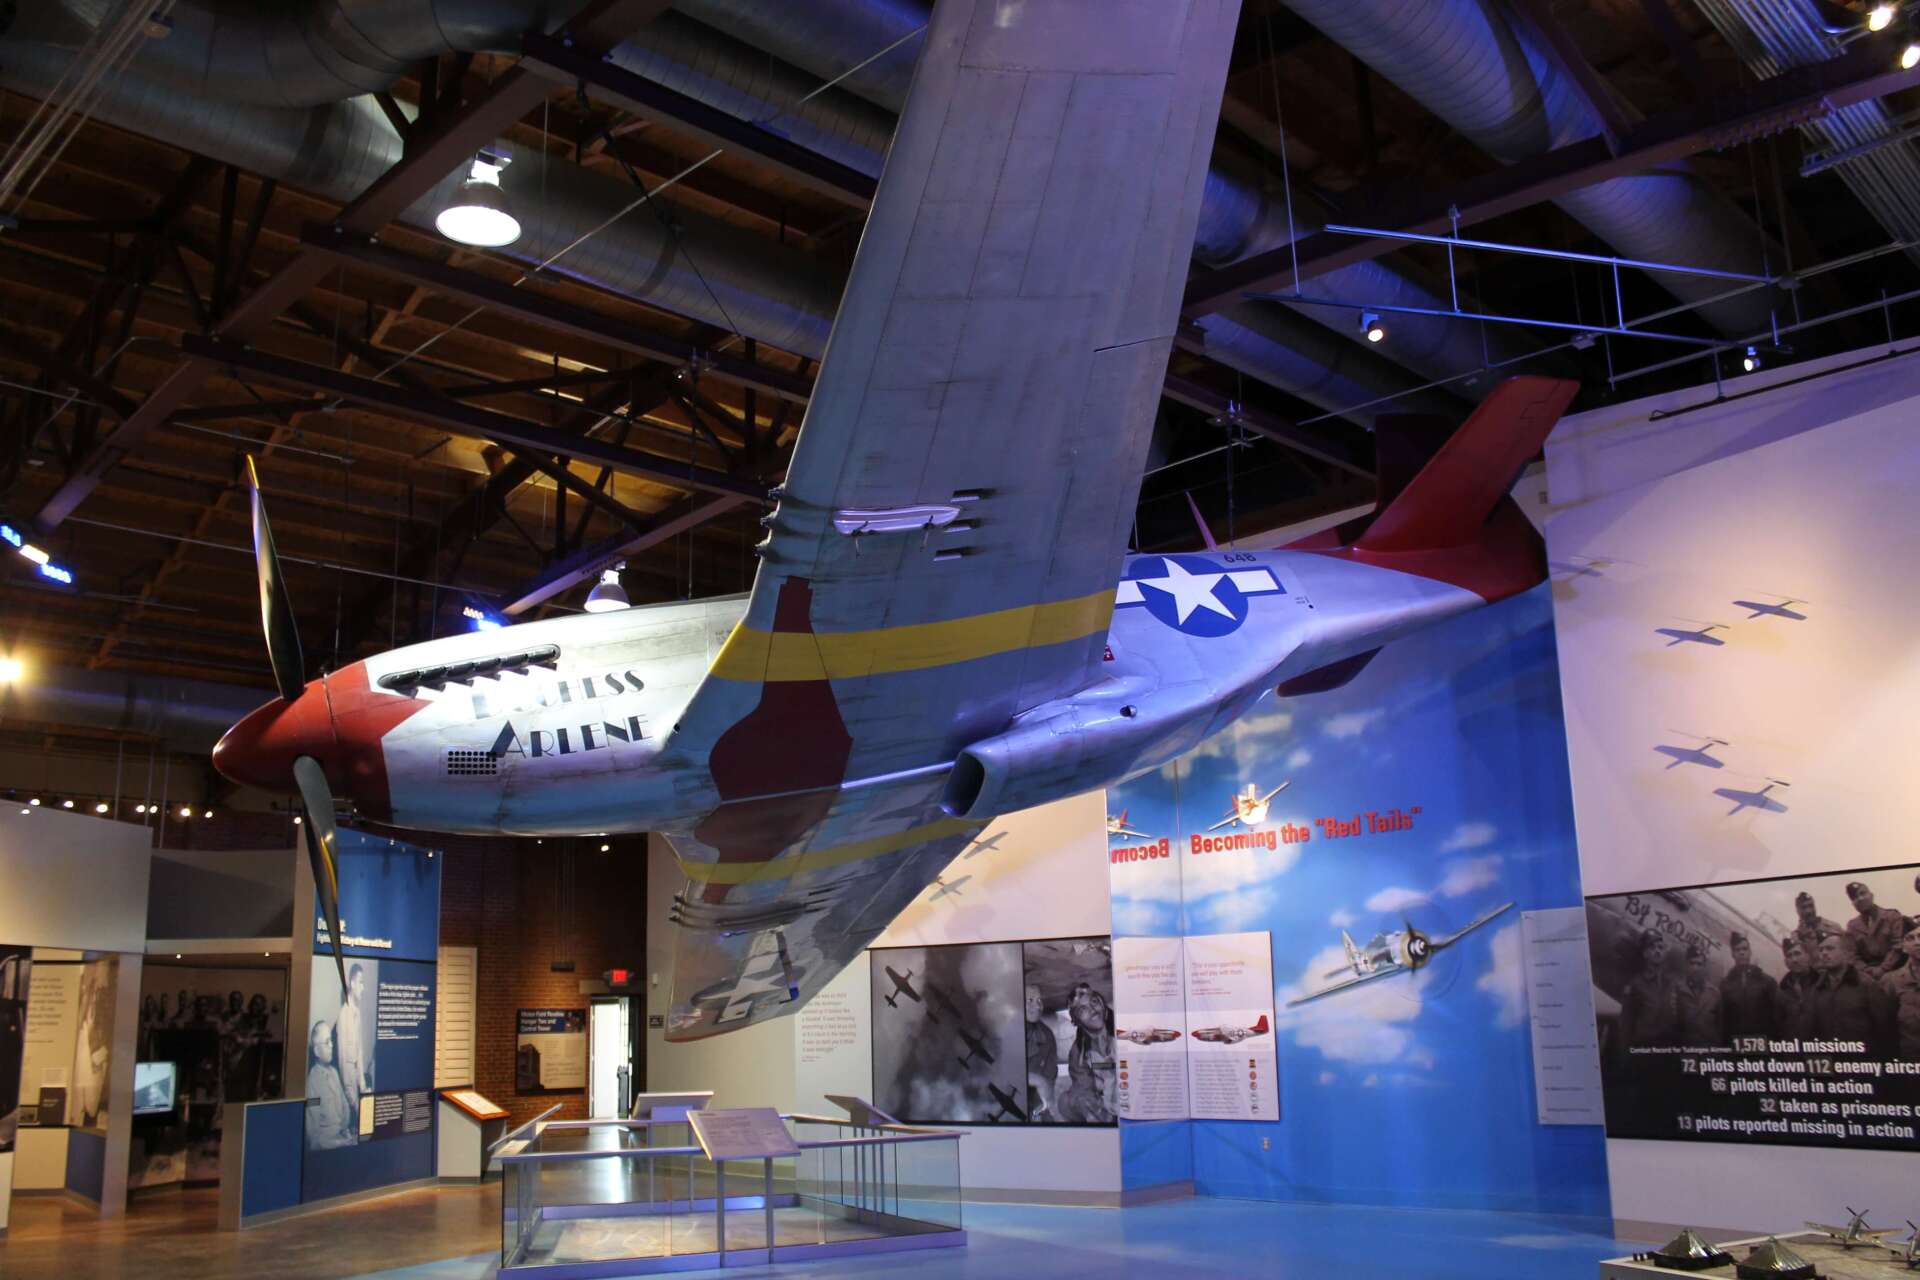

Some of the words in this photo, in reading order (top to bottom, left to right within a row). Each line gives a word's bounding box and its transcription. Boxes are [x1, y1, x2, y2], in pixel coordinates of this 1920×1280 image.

[490, 714, 653, 758] ARLENE
[1191, 829, 1277, 855] Becoming
[1281, 824, 1310, 846] the
[1315, 816, 1360, 839] "Red
[1366, 806, 1423, 833] Tails"
[1733, 1038, 1766, 1053] 1,578
[1769, 1038, 1800, 1053] total
[1802, 1037, 1866, 1053] missions
[1682, 1059, 1697, 1072] 72
[1700, 1058, 1735, 1076] pilots
[1737, 1058, 1766, 1073] shot
[1767, 1058, 1805, 1073] down
[1808, 1059, 1831, 1073] 112
[1834, 1061, 1881, 1077] enemy
[1711, 1078, 1726, 1092] 66
[1730, 1078, 1767, 1095] pilots
[1769, 1078, 1808, 1093] killed
[1811, 1079, 1825, 1093] in
[1827, 1079, 1873, 1095] action
[1760, 1098, 1776, 1112] 32
[1780, 1098, 1818, 1113] taken
[1821, 1102, 1838, 1114] as
[1841, 1100, 1911, 1118] prisoners
[1678, 1116, 1692, 1129] 13
[1695, 1115, 1730, 1133] pilots
[1733, 1117, 1788, 1134] reported
[1791, 1119, 1846, 1138] missing
[1848, 1120, 1863, 1135] in
[1866, 1121, 1914, 1138] action
